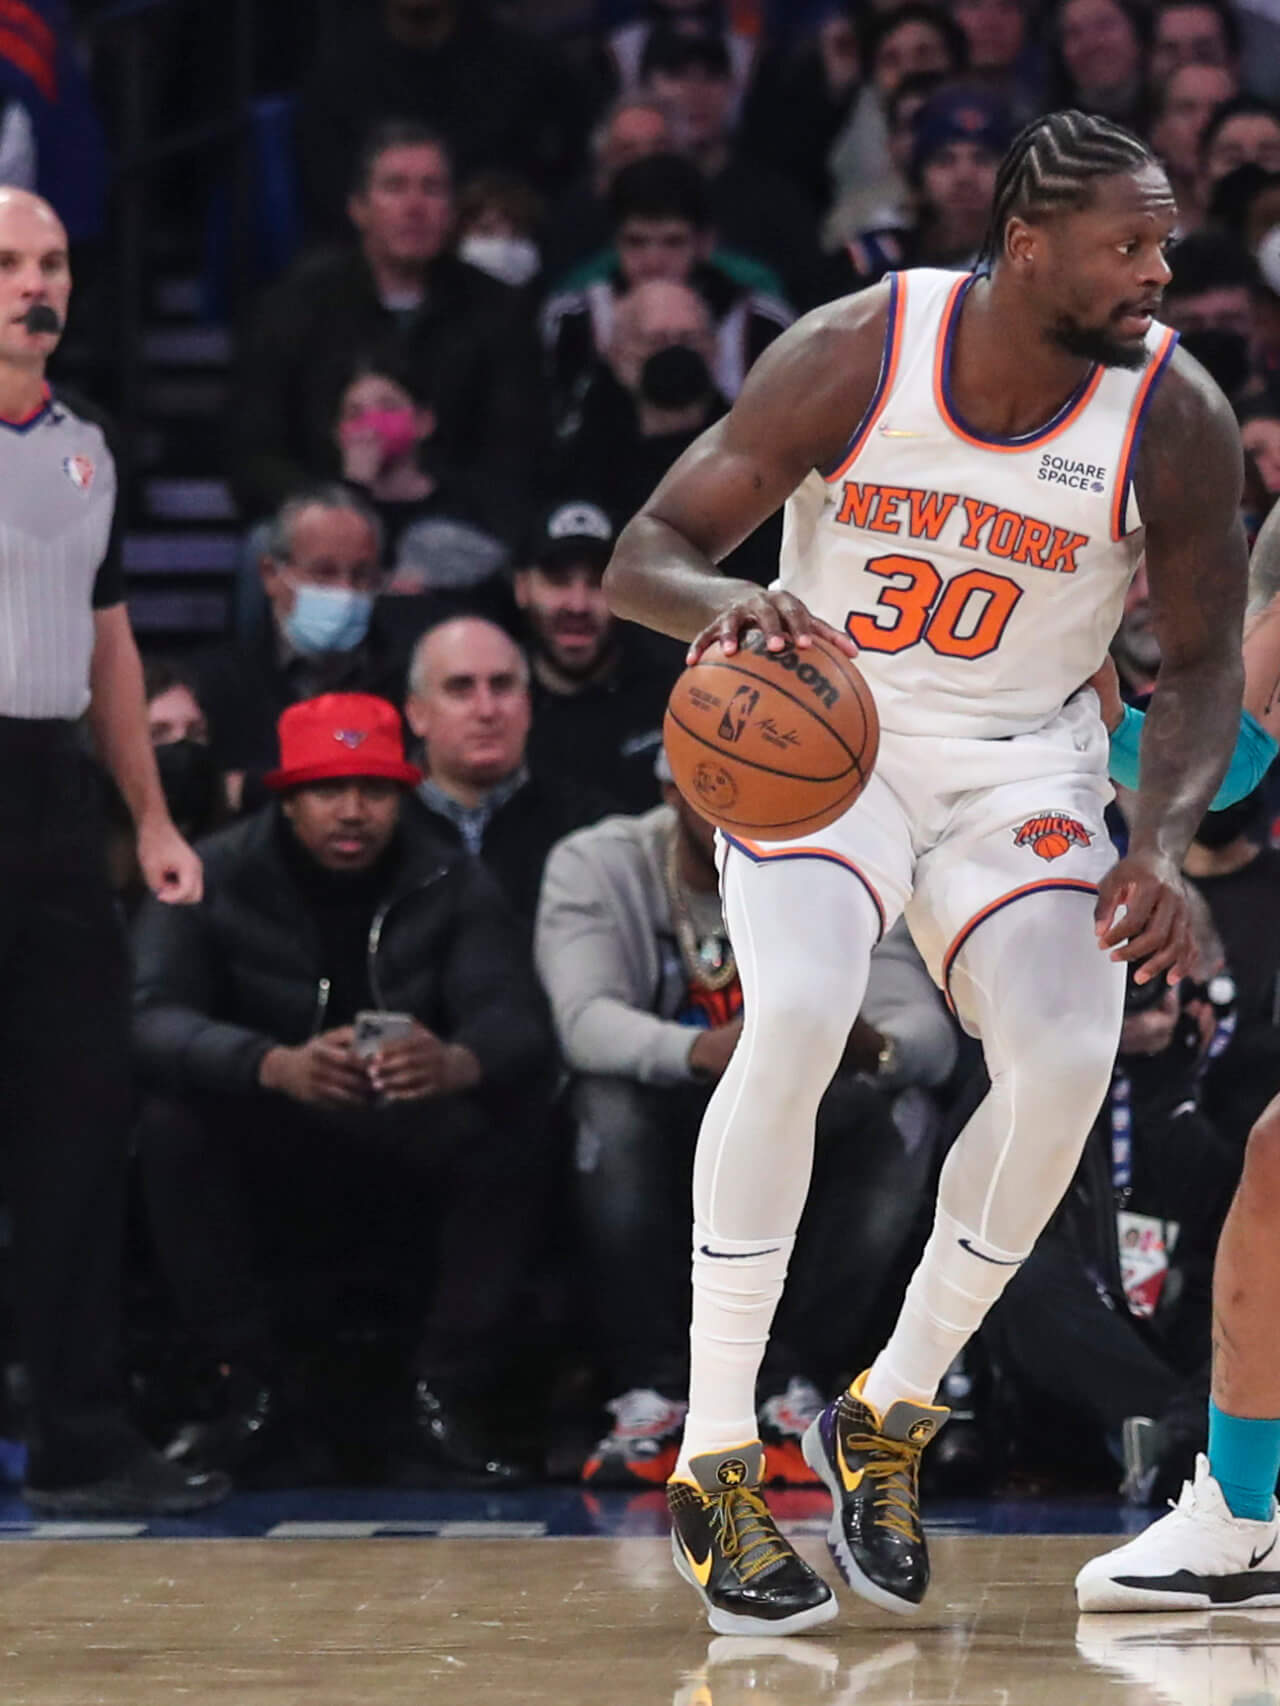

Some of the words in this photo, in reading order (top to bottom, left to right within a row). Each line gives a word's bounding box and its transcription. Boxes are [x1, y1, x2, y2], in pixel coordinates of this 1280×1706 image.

[1037, 467, 1090, 491] SPACE
[1040, 453, 1107, 480] SQUARE
[836, 482, 958, 541] NEW
[959, 499, 1090, 574] YORK
[845, 553, 1024, 661] 30
[1014, 817, 1091, 847] KNICKS
